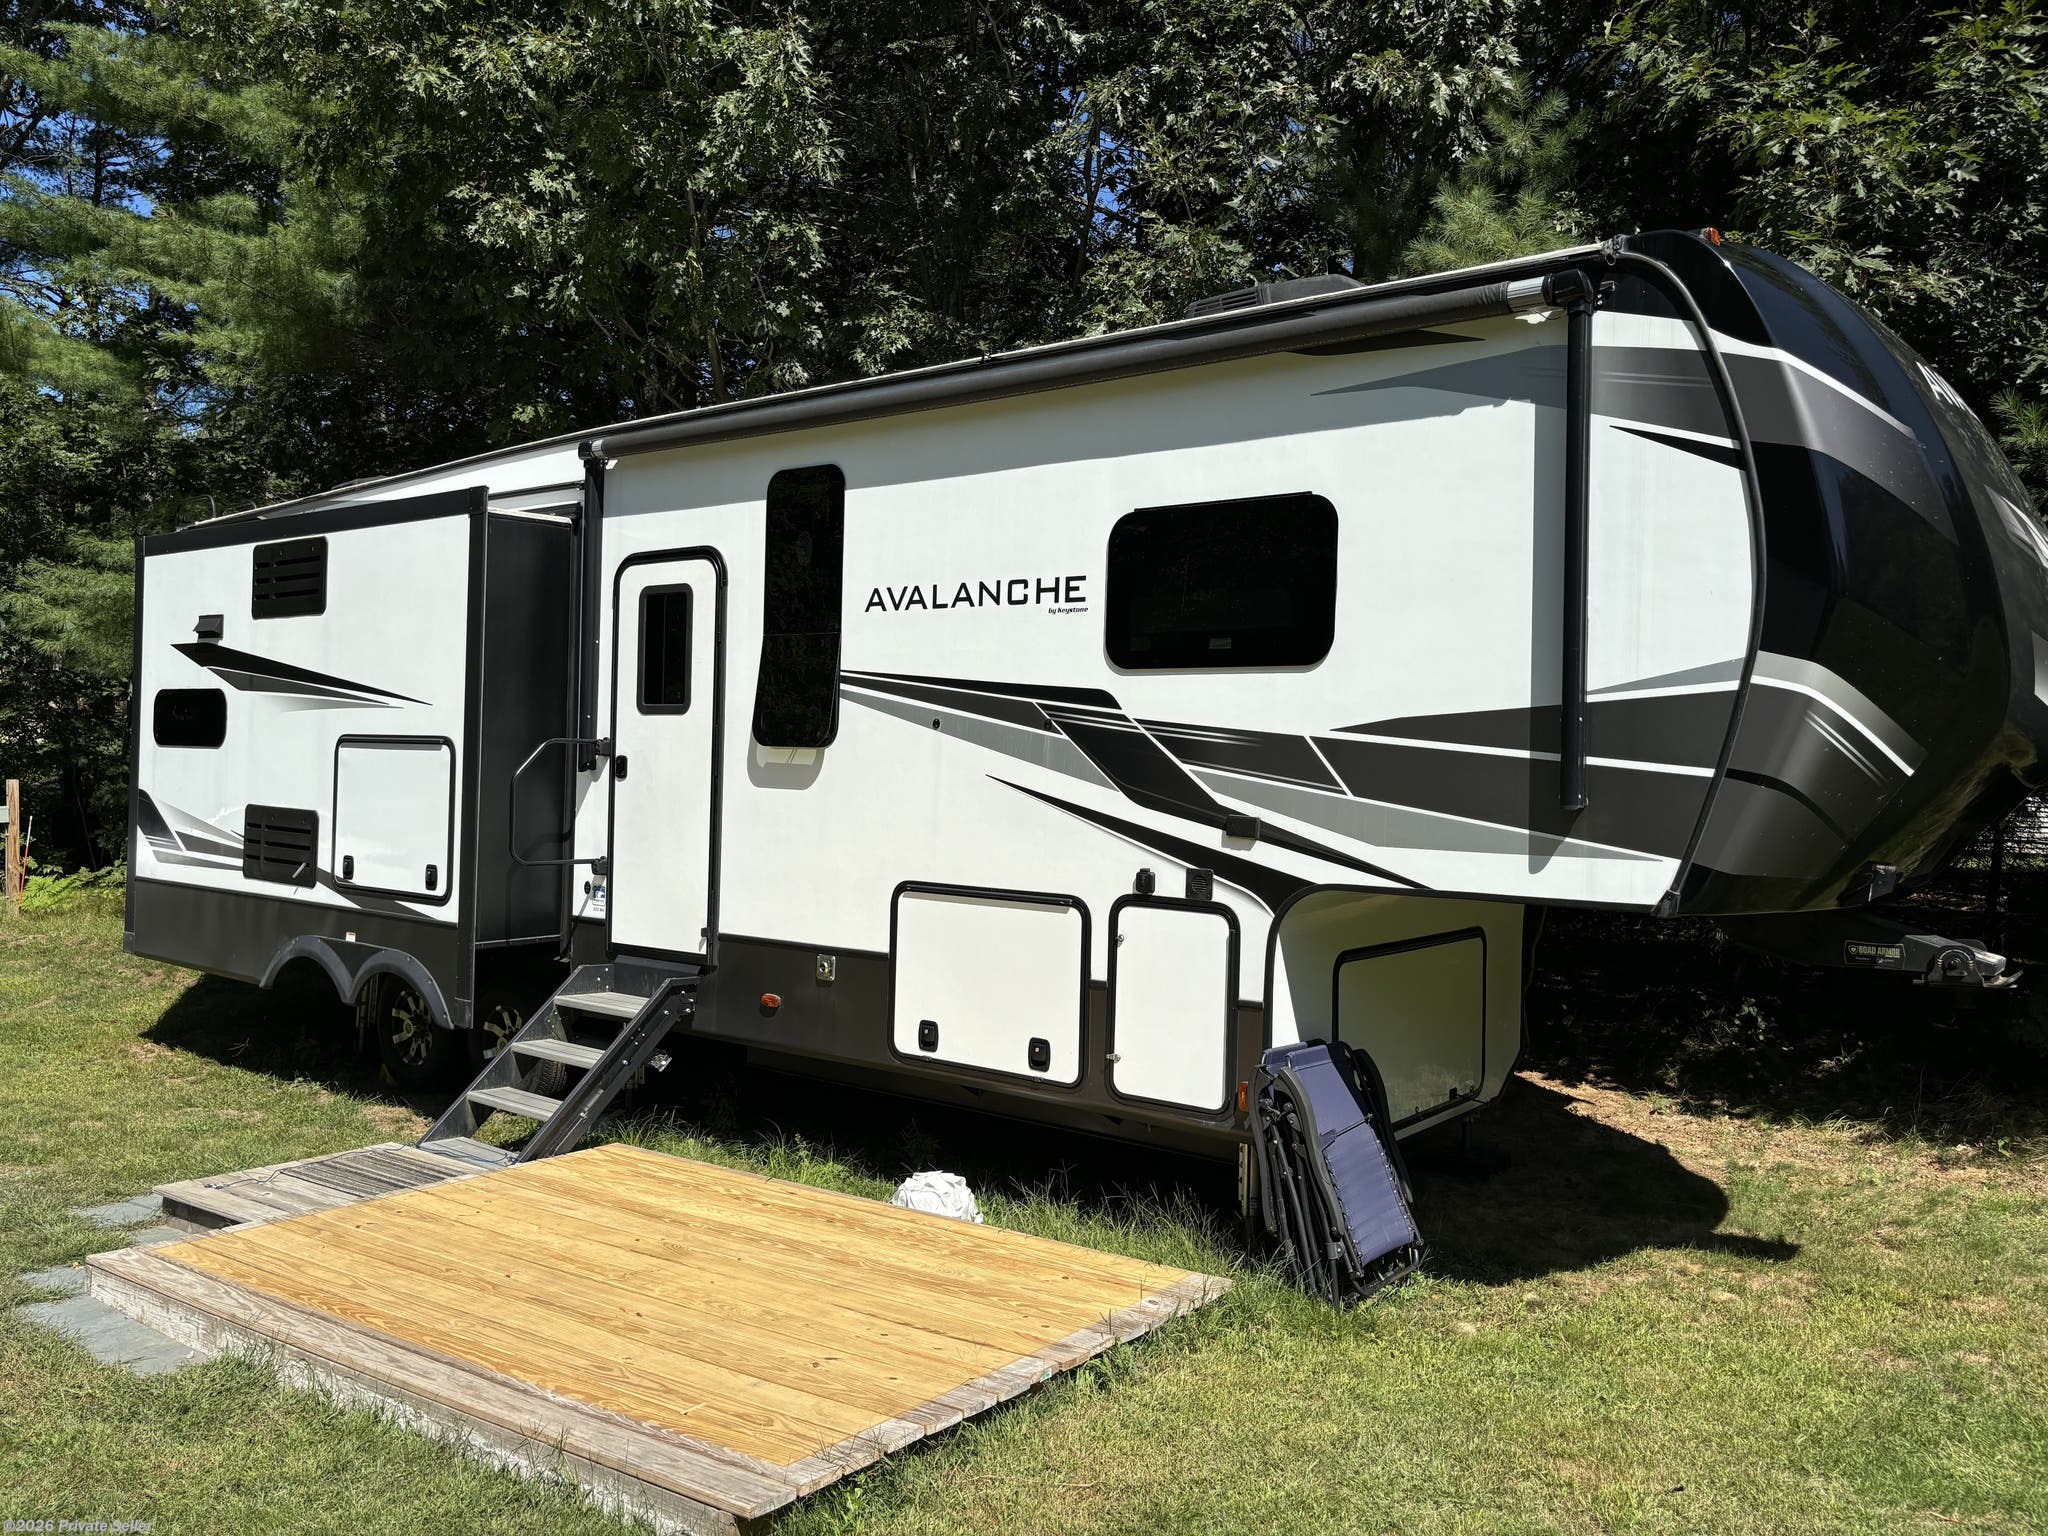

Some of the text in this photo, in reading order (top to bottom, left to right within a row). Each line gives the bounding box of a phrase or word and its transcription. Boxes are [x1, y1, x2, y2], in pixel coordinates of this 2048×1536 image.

[864, 575, 1087, 612] AVALANCHE
[1048, 606, 1089, 615] by Keystone
[1859, 945, 1901, 957] ROAD ARMOR
